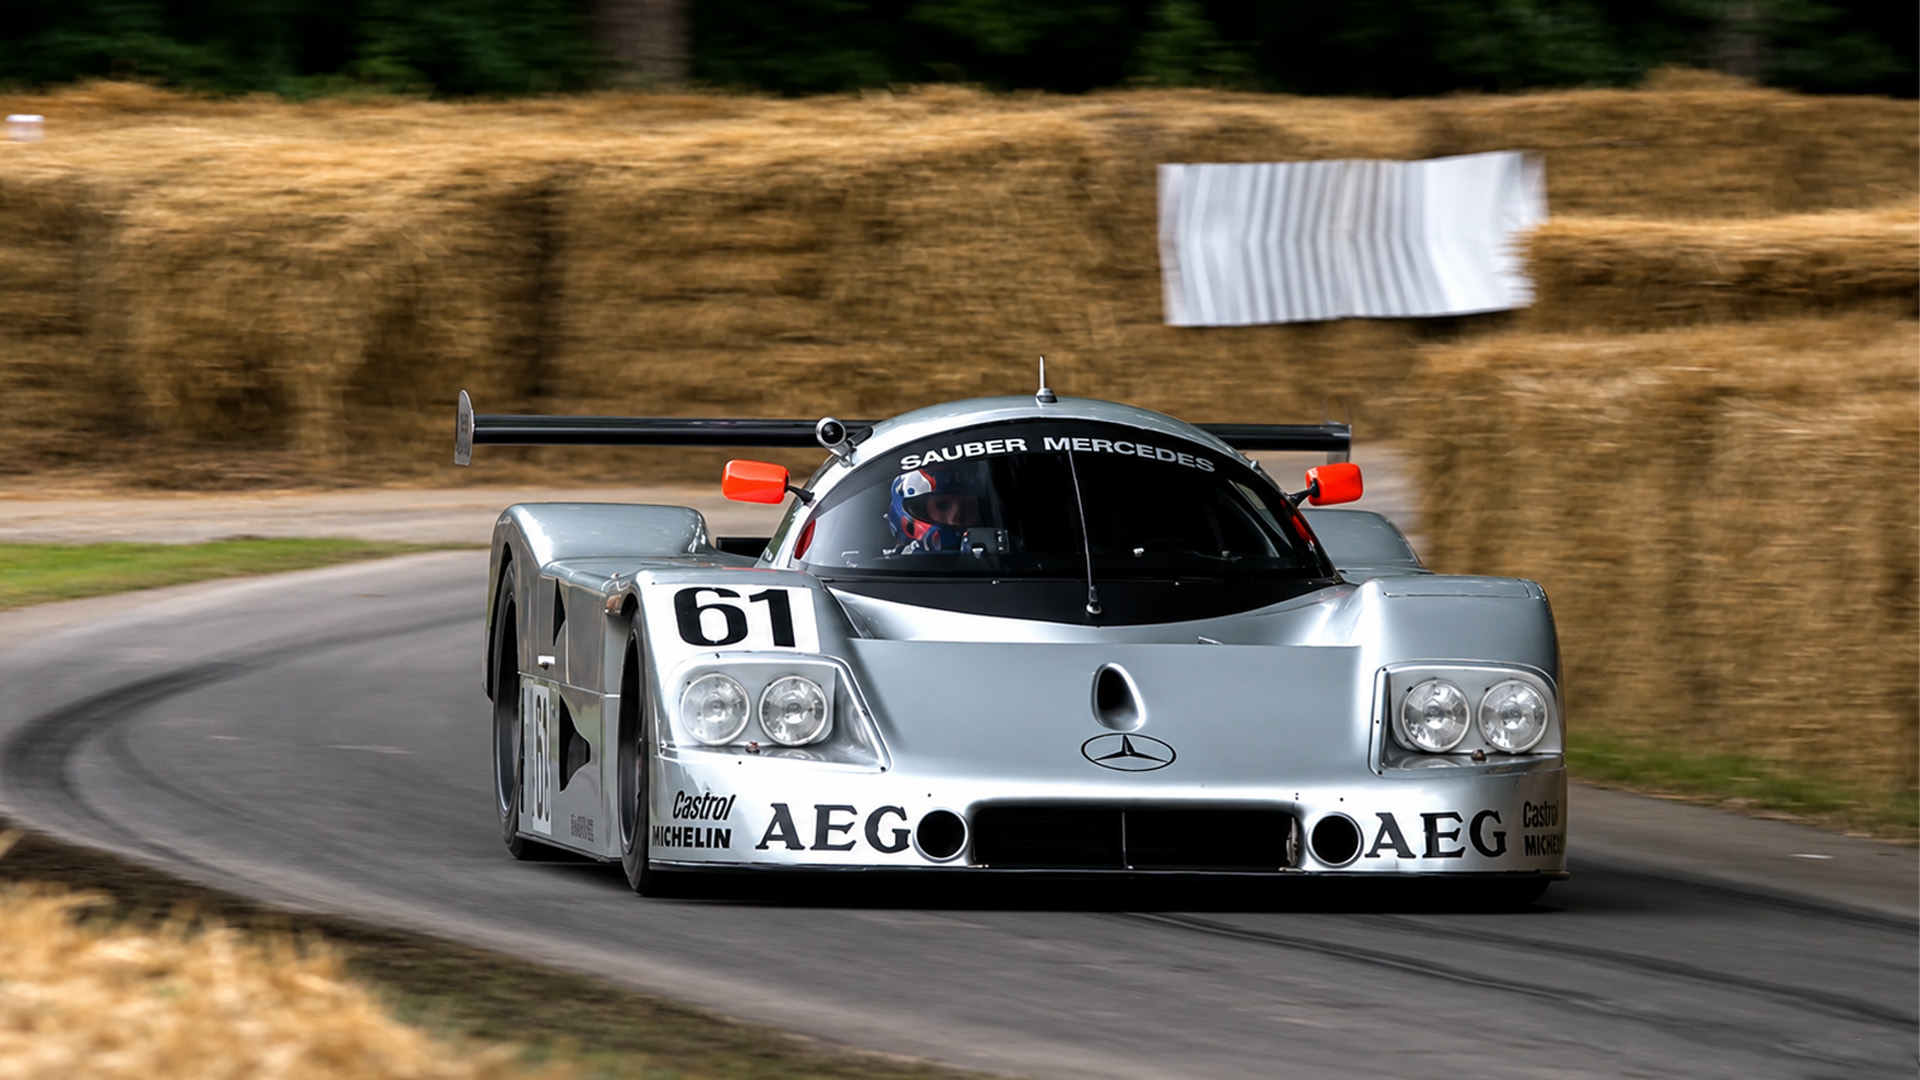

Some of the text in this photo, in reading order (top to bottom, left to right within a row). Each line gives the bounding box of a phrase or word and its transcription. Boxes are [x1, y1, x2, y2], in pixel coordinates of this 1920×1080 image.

[901, 437, 1216, 473] SAUBER MERCEDES
[673, 586, 796, 648] 61
[674, 790, 737, 821] Castrol
[652, 825, 732, 849] MICHELIN
[755, 803, 911, 853] AEG
[1364, 809, 1507, 858] AEG
